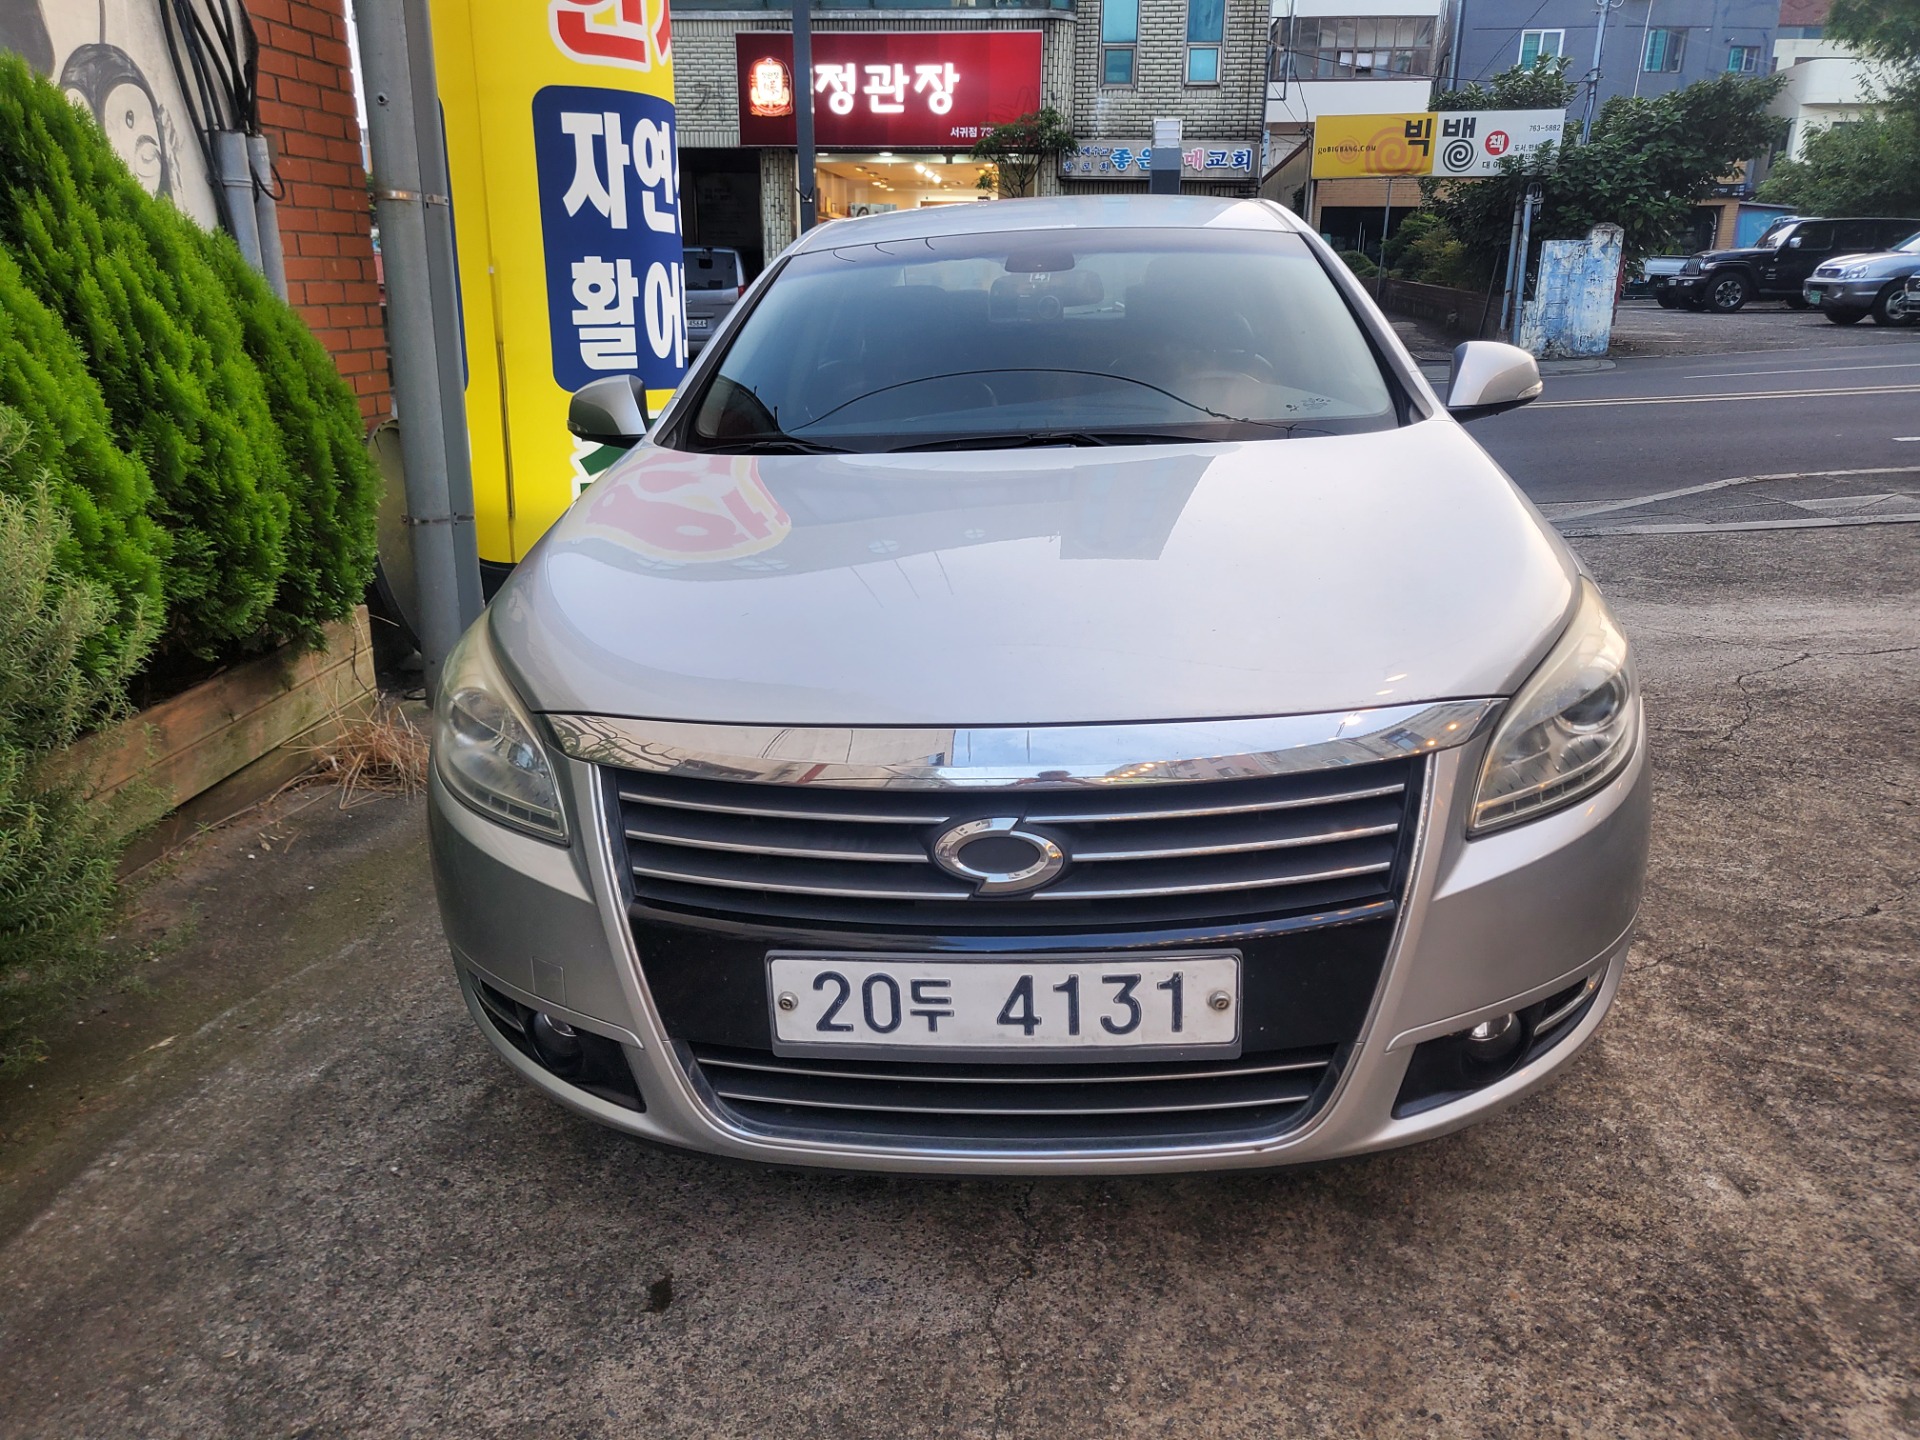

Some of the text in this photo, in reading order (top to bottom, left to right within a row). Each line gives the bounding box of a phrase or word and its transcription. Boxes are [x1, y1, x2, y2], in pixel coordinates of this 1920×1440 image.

[815, 62, 960, 116] 정관장
[950, 127, 978, 139] 서귀점
[1183, 147, 1253, 173] 매교회
[1488, 134, 1506, 153] 책
[560, 112, 683, 237] 자연
[570, 256, 689, 371] 활어
[812, 970, 1184, 1037] 20두 4131
